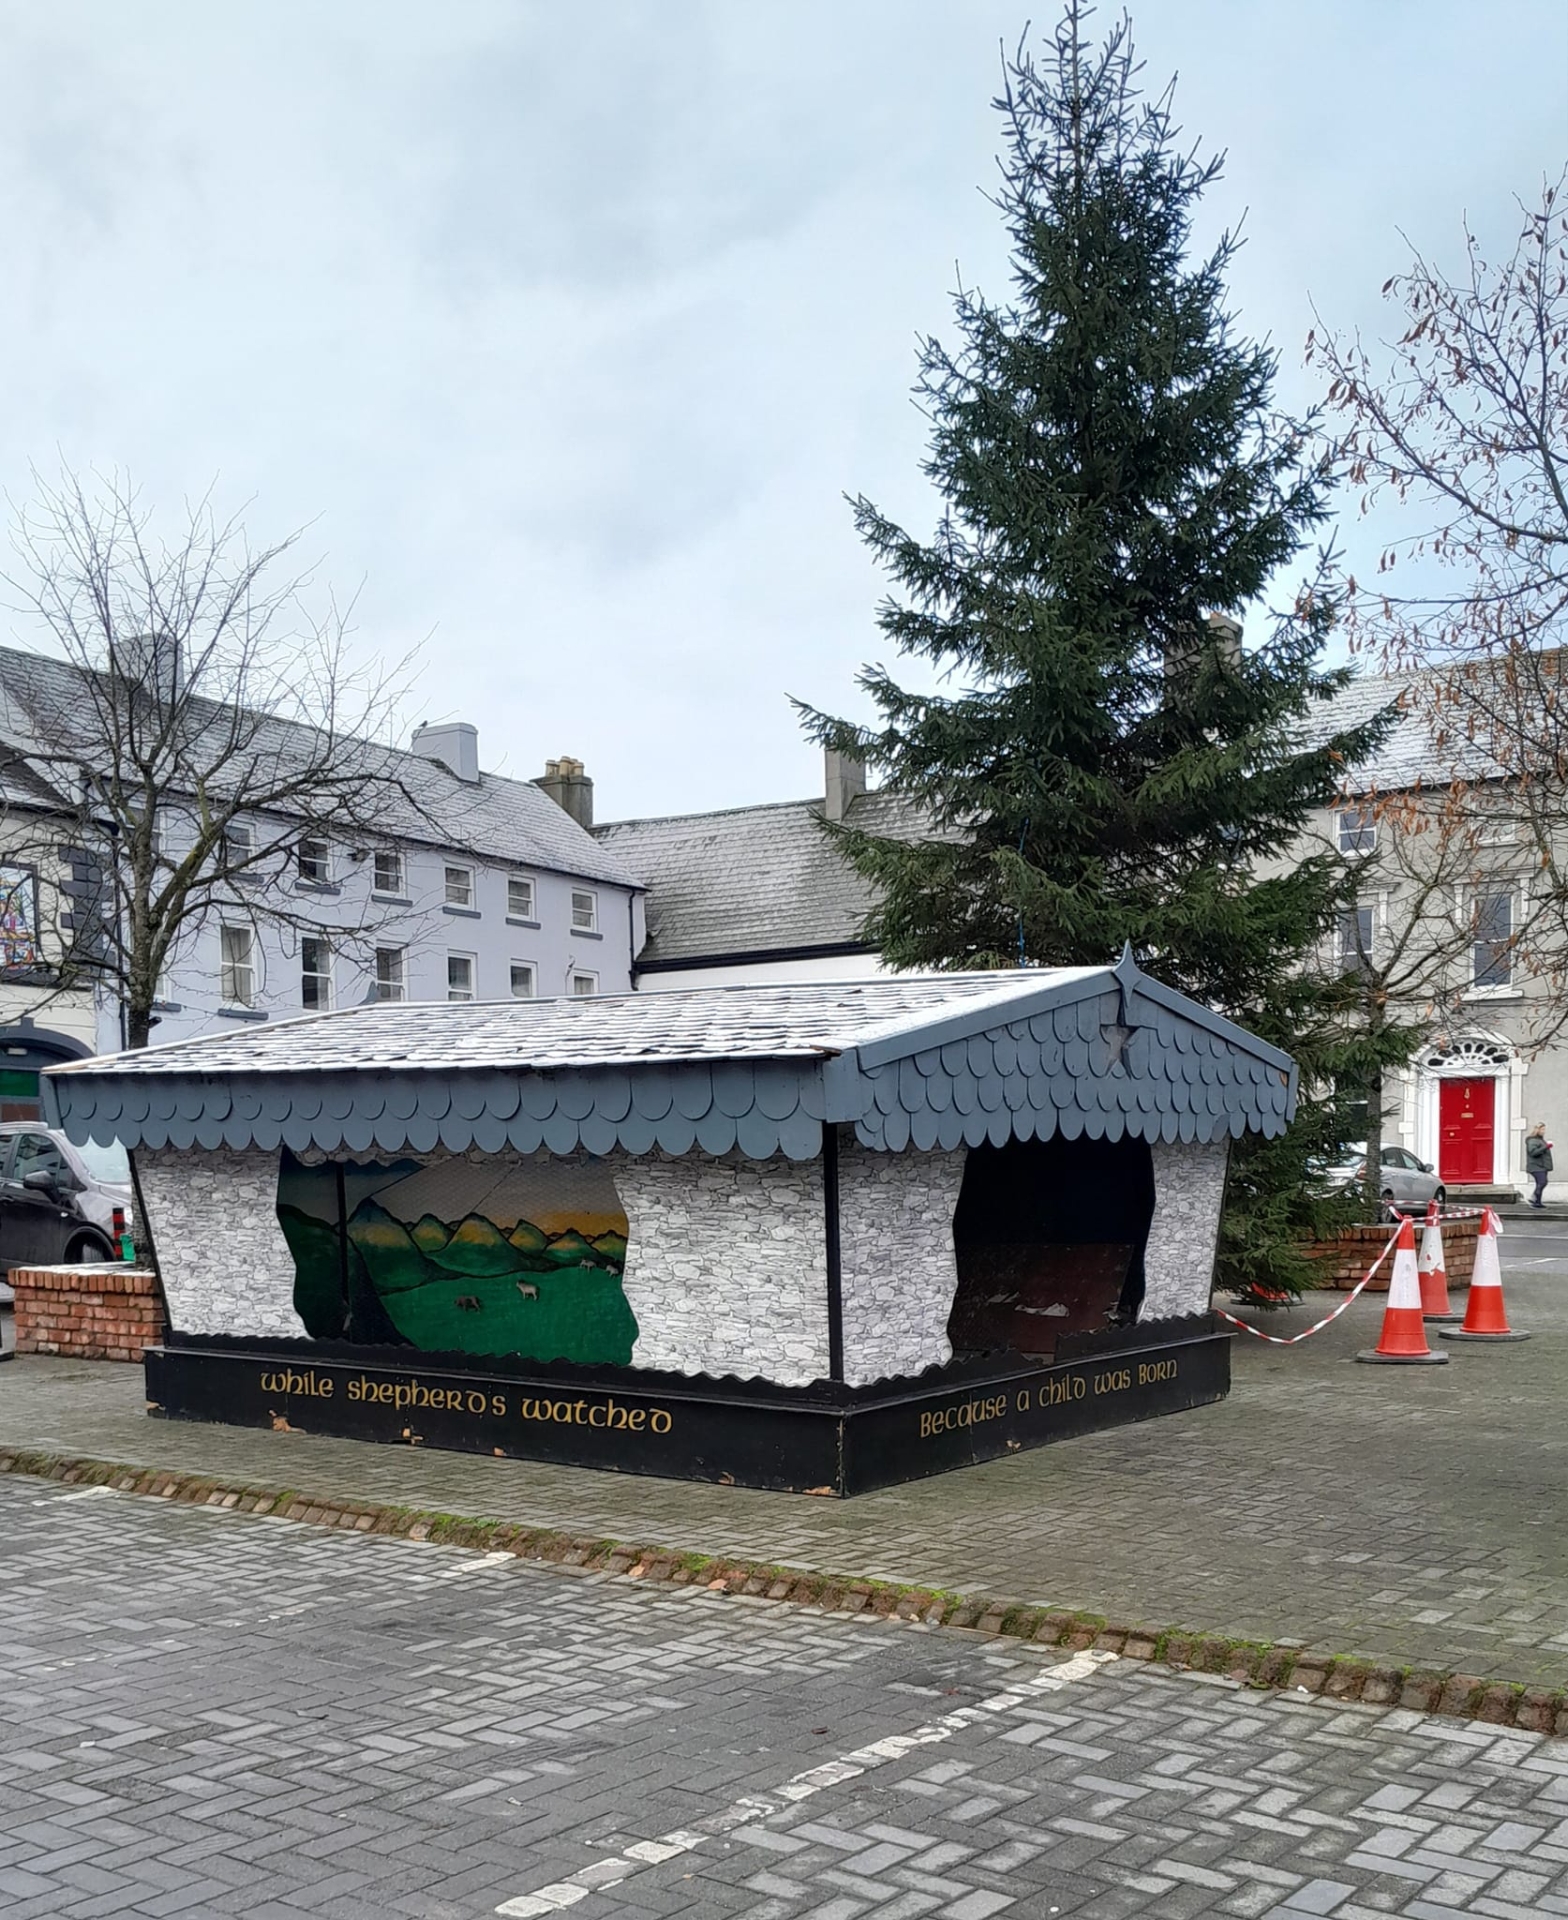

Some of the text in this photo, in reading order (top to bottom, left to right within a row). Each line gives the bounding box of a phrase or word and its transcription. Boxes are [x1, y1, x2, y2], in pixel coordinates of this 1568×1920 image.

[260, 1368, 334, 1398] while
[521, 1397, 673, 1434] watched
[1016, 1389, 1030, 1412] a
[1039, 1376, 1086, 1407] child
[1094, 1368, 1131, 1396] was
